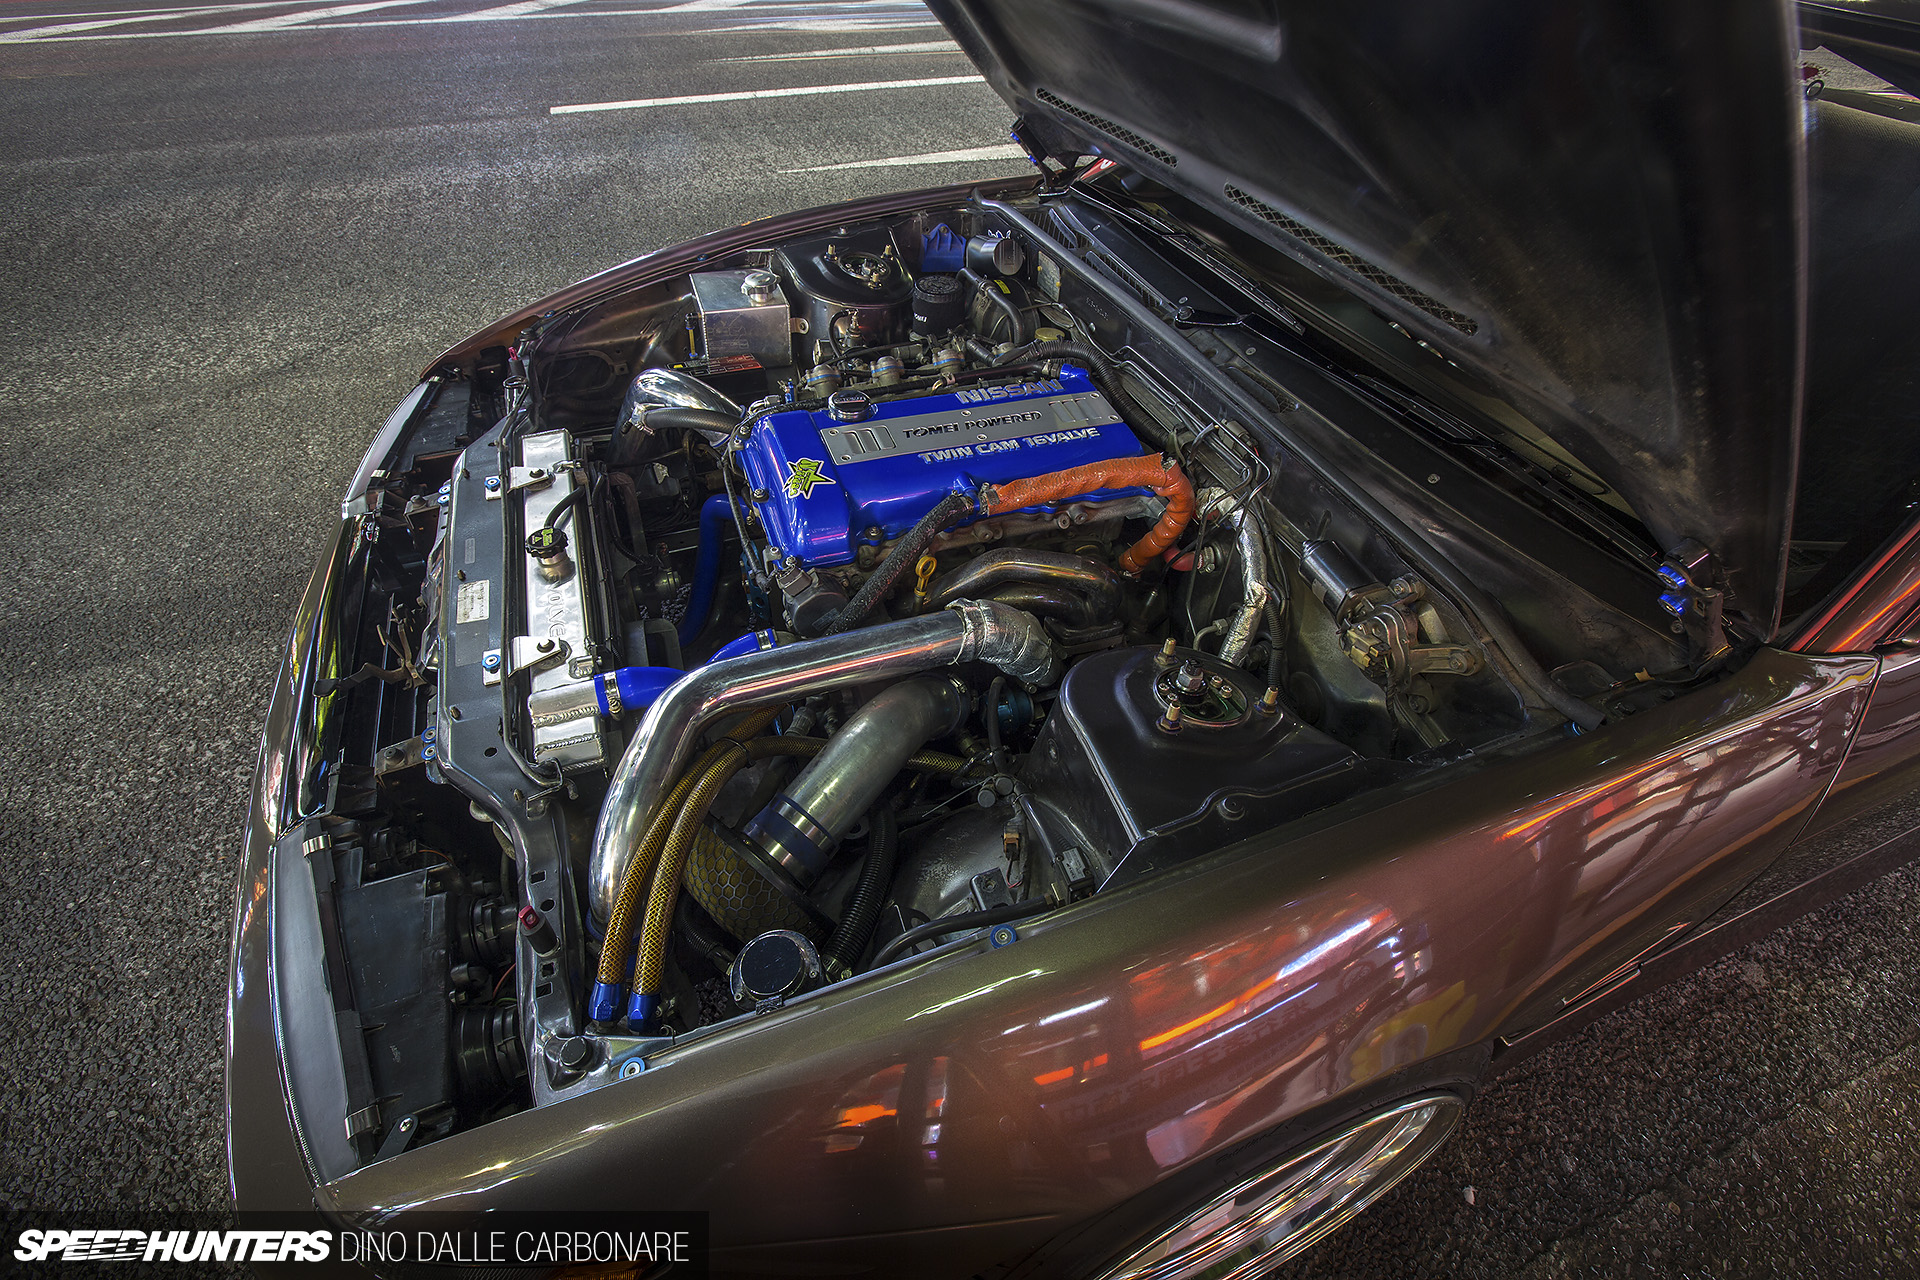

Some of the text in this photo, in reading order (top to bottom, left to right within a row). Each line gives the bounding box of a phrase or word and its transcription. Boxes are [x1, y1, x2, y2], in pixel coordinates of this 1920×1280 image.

[955, 379, 1064, 404] NISSAN
[903, 410, 1042, 438] TOMEI POWERED
[918, 427, 1101, 465] TWIN CAM 16VALVE
